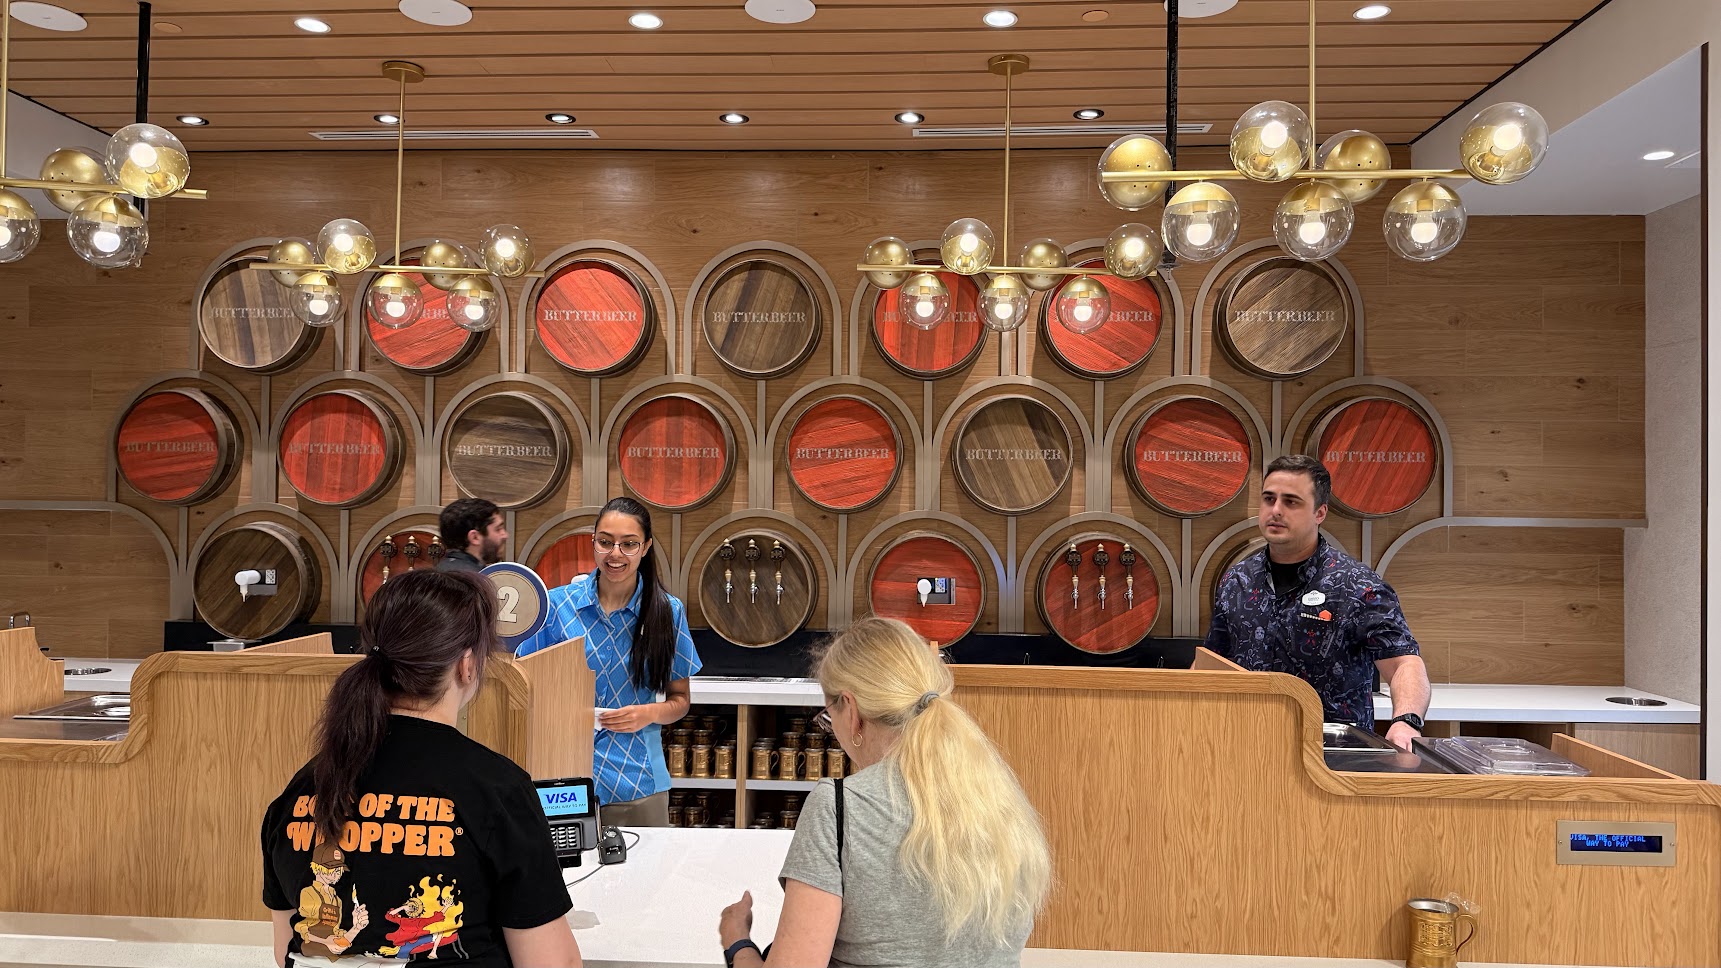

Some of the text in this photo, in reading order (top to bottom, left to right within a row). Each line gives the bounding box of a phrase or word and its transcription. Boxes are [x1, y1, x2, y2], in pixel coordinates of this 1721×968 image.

[543, 308, 637, 321] BUTTERBEER
[712, 311, 806, 322] BUTTERBEER
[1235, 310, 1336, 321] BUTTERBEER
[125, 440, 216, 453] BUTTERBEER
[288, 442, 380, 454] BUTTERBEER
[457, 444, 552, 456] BUTTERBEER
[627, 446, 720, 458] BUTTERBEER
[796, 447, 889, 459] BUTTERBEER
[965, 448, 1061, 460] BUTTERBEER
[1143, 449, 1242, 462] BUTTERBEER
[1325, 450, 1425, 462] BUTTERBEER
[497, 586, 520, 623] 2
[546, 792, 577, 803] VISA
[359, 793, 393, 818] OF
[397, 795, 456, 822] THE
